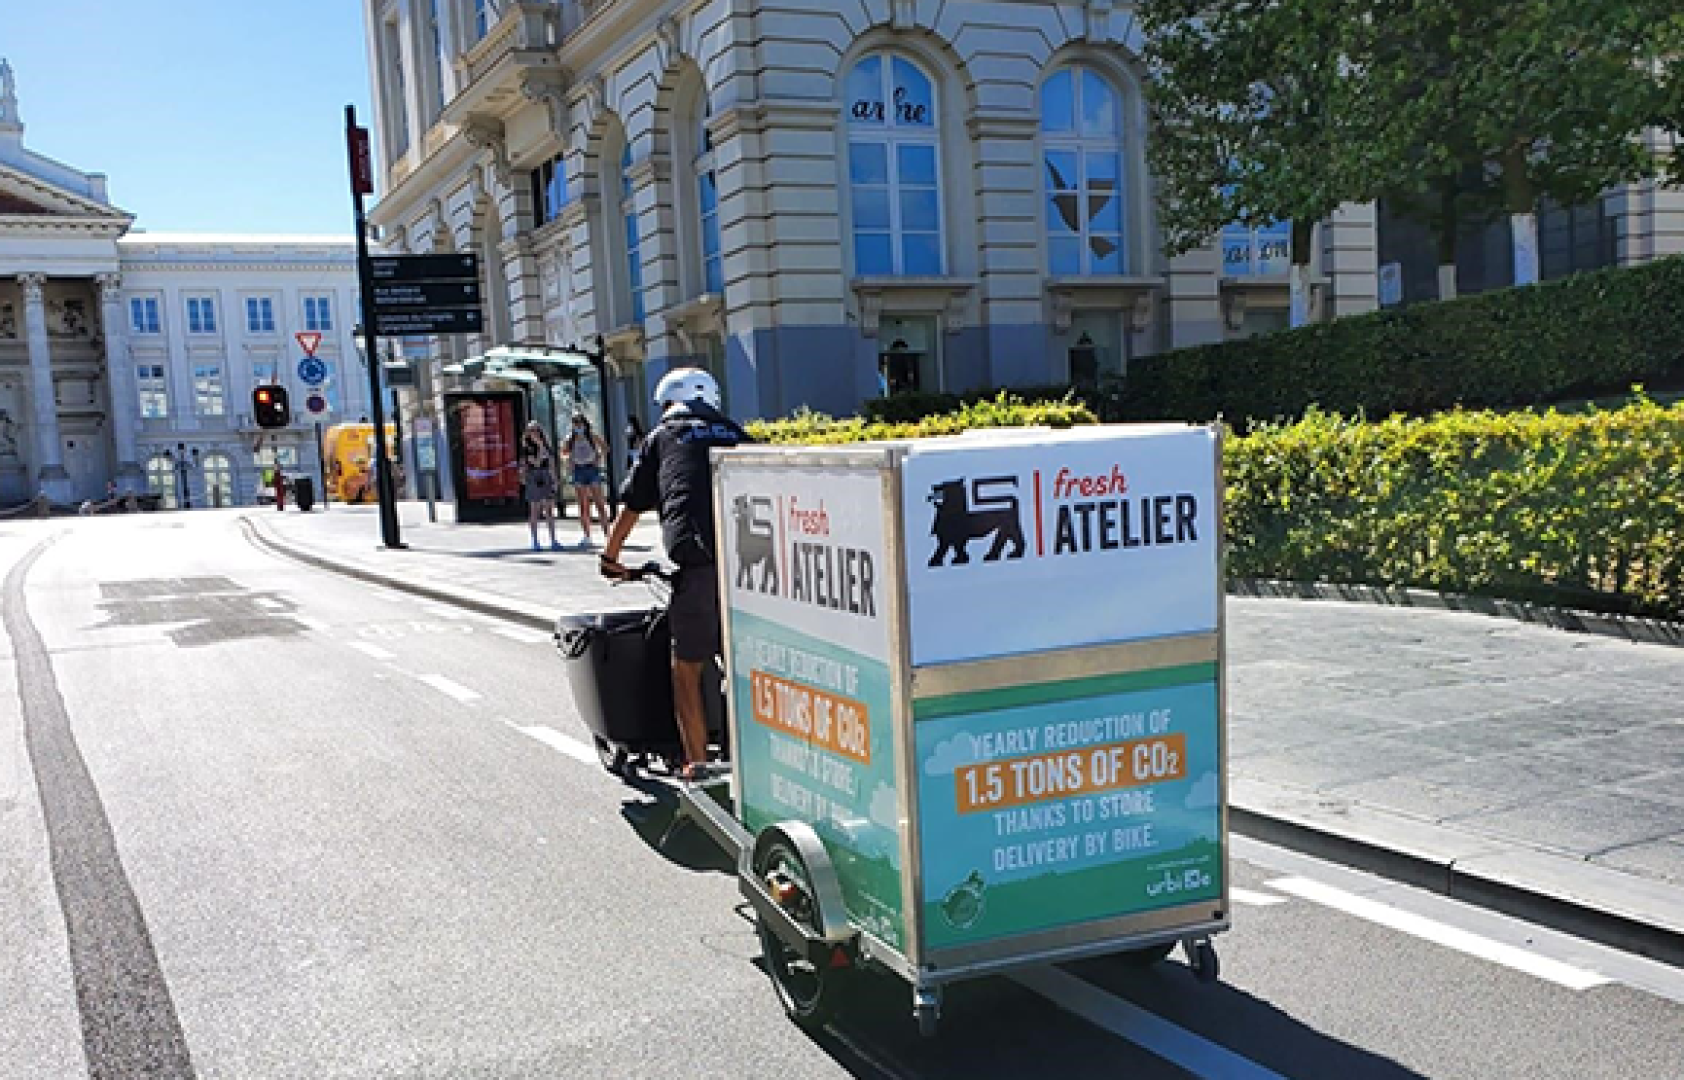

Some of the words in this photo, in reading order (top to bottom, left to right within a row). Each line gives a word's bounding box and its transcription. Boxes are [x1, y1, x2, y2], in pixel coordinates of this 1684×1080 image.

[1053, 463, 1128, 497] fresh
[789, 496, 830, 537] fresh
[1053, 494, 1198, 555] ATELIER
[791, 540, 876, 618] ATELIER
[969, 726, 1038, 760] YEARLY
[1044, 712, 1144, 747] REDUCTION
[1149, 709, 1172, 733] OF
[965, 765, 1004, 804] 1.5
[1010, 753, 1083, 798] TONS
[1091, 747, 1124, 786] OF
[993, 803, 1066, 836] THANKS
[1072, 799, 1094, 823] TO
[1099, 790, 1154, 819] STORE
[993, 835, 1078, 871] DELIVERY
[1085, 831, 1107, 856] BY
[1112, 822, 1159, 852] BIKE.
